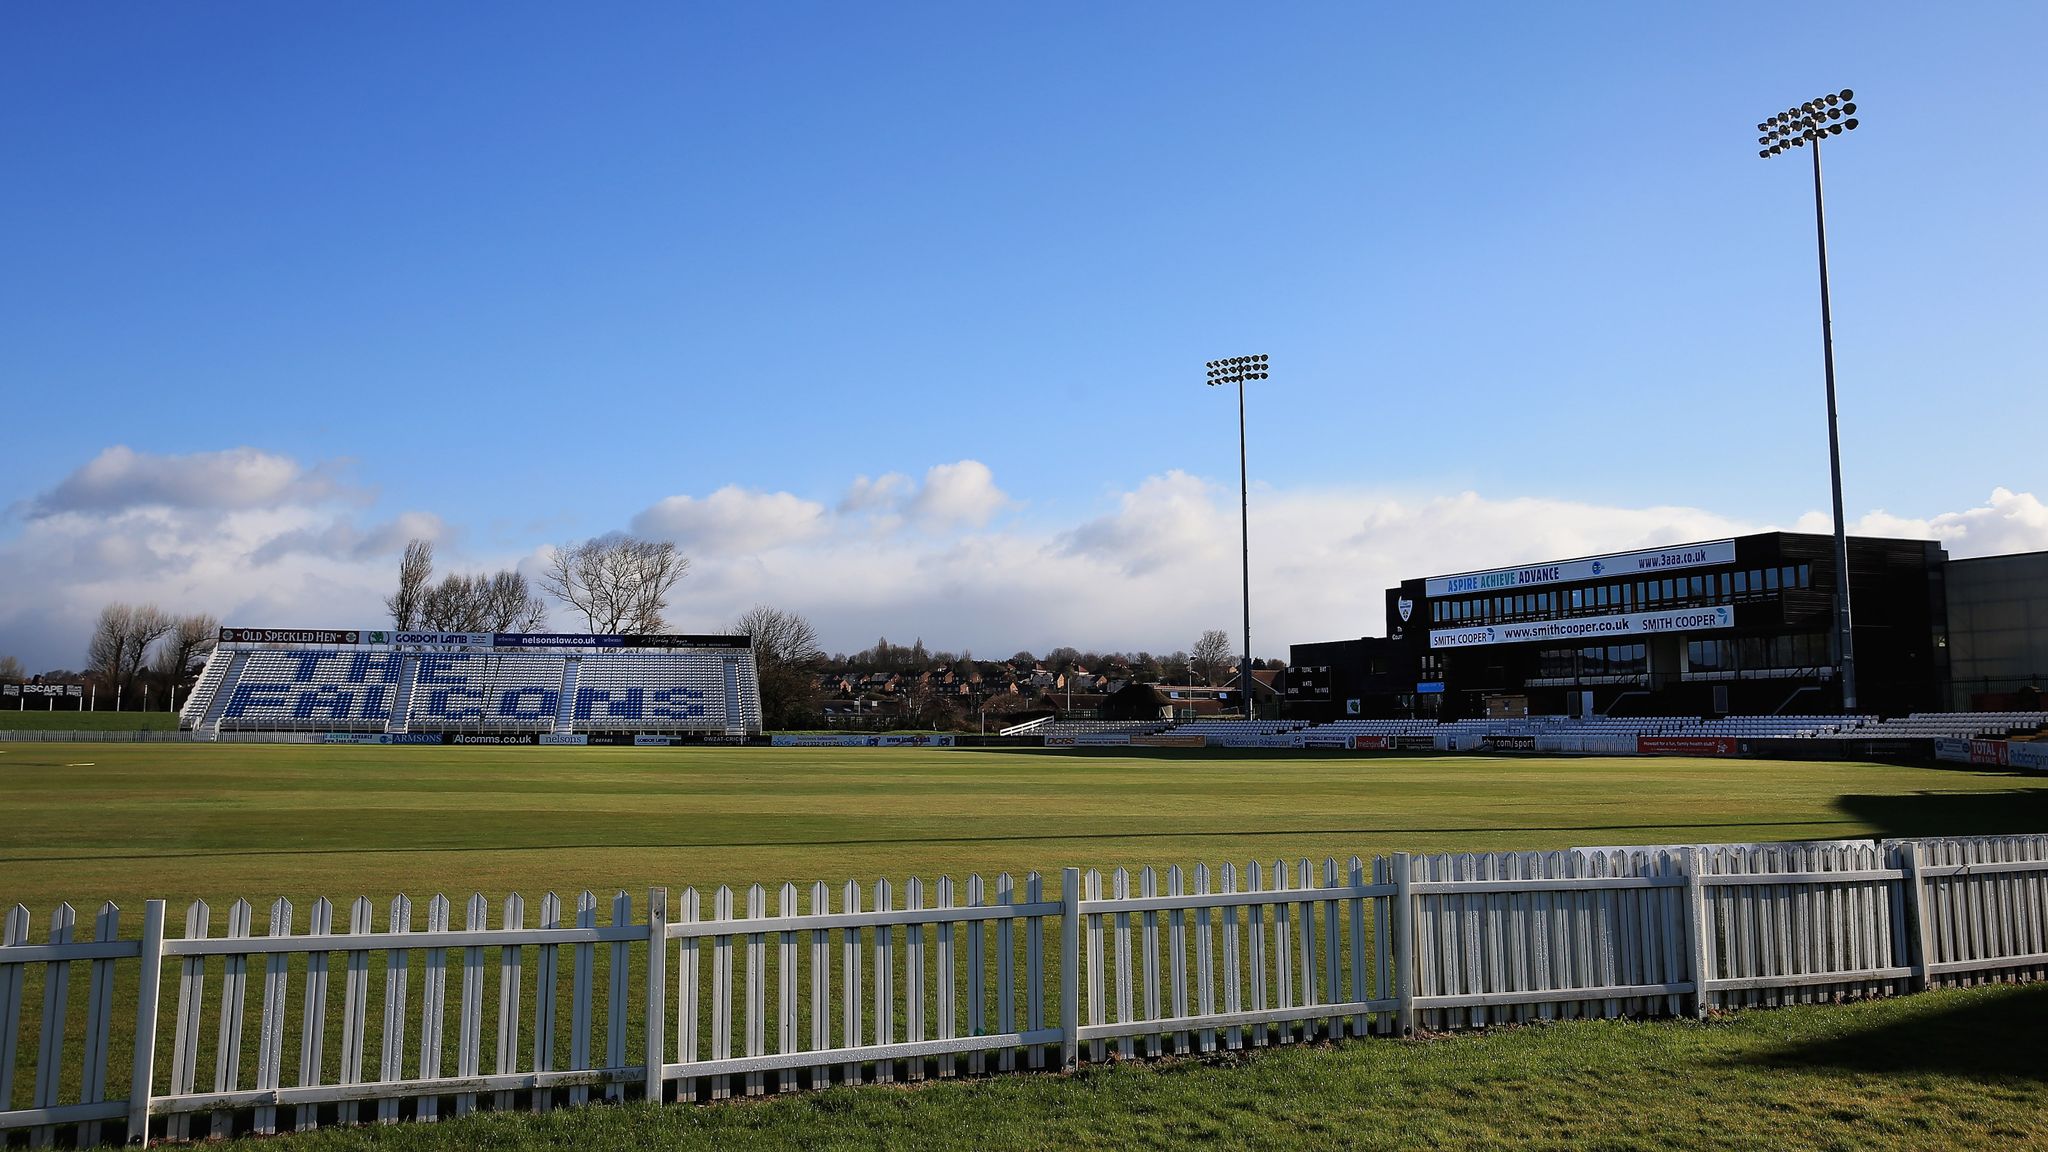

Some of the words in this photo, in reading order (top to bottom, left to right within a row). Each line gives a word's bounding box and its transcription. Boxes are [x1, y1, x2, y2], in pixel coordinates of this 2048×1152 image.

[1638, 549, 1706, 569] www.3aaa.co.uk
[1447, 577, 1478, 592] ASPIRE
[1480, 572, 1516, 588] ACHIEVE
[1518, 567, 1560, 584] ADVANCE
[1504, 618, 1630, 639] www.smithcooper.co.uk
[1642, 618, 1672, 631] SMITH
[1675, 614, 1716, 627] COOPER
[265, 630, 314, 642] SPECKLED
[395, 634, 438, 643] GORDON
[440, 634, 467, 643] LAMB
[522, 637, 596, 645] nelsonslaw.co.uk
[1434, 635, 1455, 646] SMITH
[1457, 632, 1487, 644] COOPER
[286, 652, 474, 682] THE
[23, 685, 64, 693] ESCAPE
[224, 683, 706, 720] FALCONS
[394, 734, 442, 743] ARMSONS
[545, 735, 582, 743] nelsons
[1972, 742, 1997, 756] TOTAL
